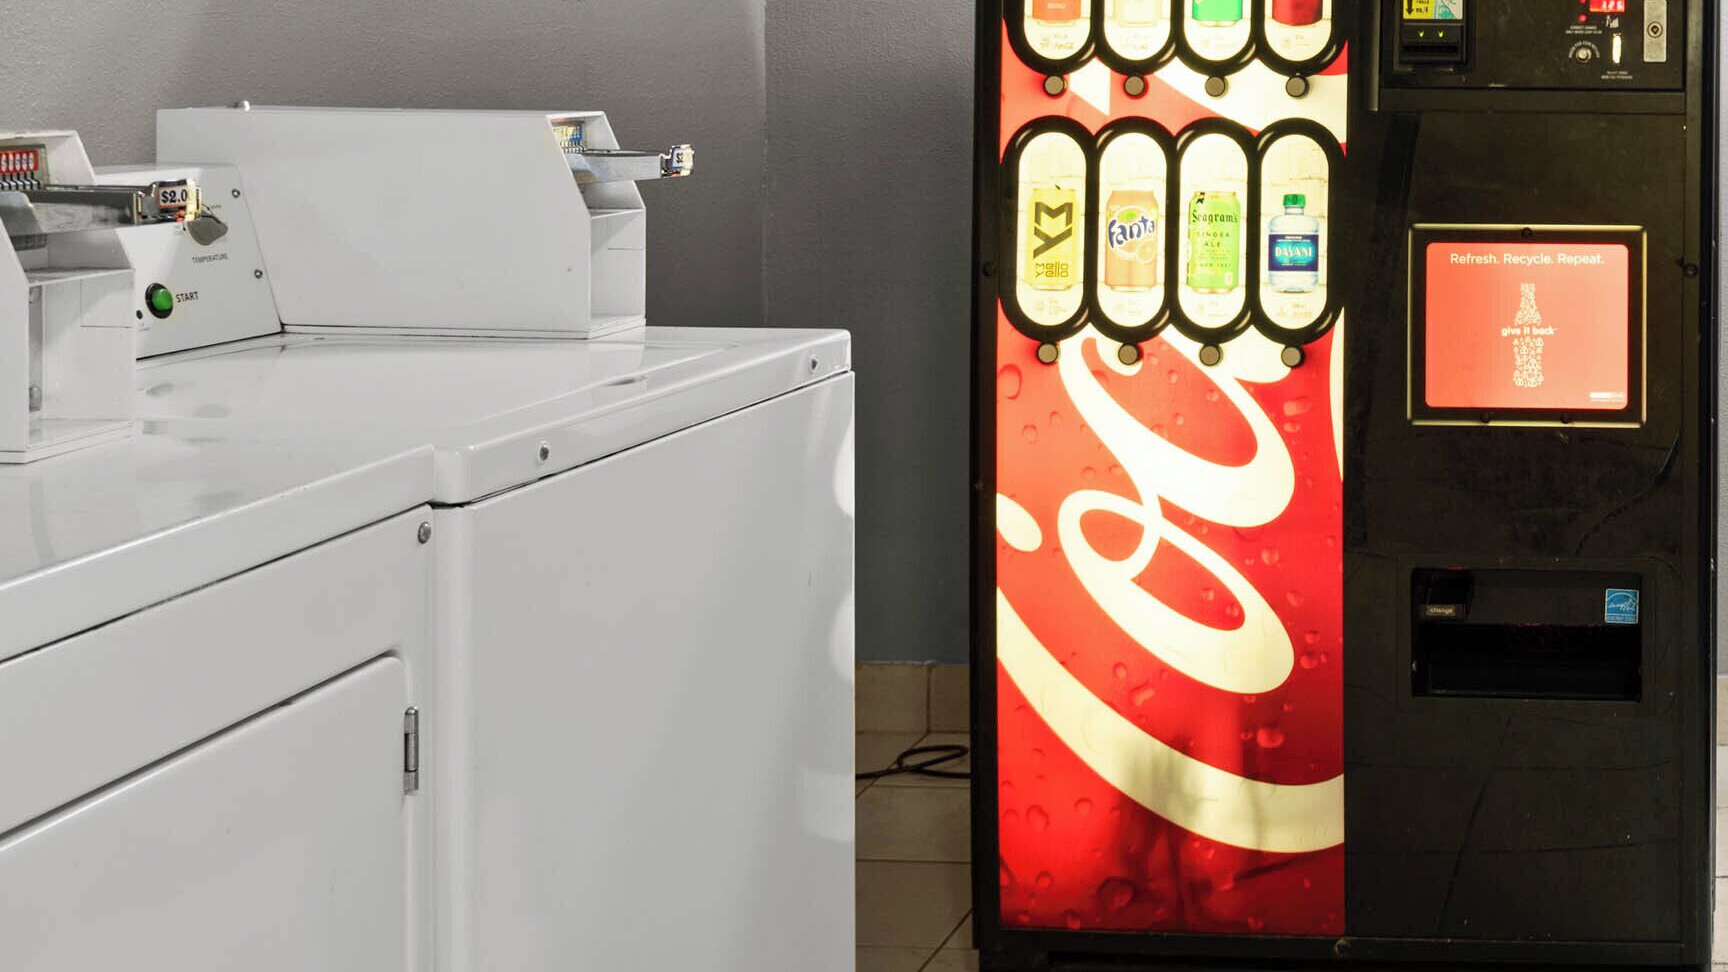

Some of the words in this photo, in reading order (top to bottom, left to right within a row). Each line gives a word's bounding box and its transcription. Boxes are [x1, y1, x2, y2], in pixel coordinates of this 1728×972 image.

[1192, 209, 1238, 223] Seagram's
[1108, 215, 1155, 249] Fanta
[1275, 245, 1312, 258] DASANI
[1035, 260, 1069, 270] Mello
[1450, 253, 1500, 264] Refresh.
[1503, 253, 1554, 265] Recycle.
[1558, 254, 1605, 266] Repeat.
[1035, 270, 1069, 278] Yello
[176, 291, 199, 303] START
[1501, 326, 1521, 336] give
[1523, 326, 1530, 335] it
[1533, 326, 1554, 335] back
